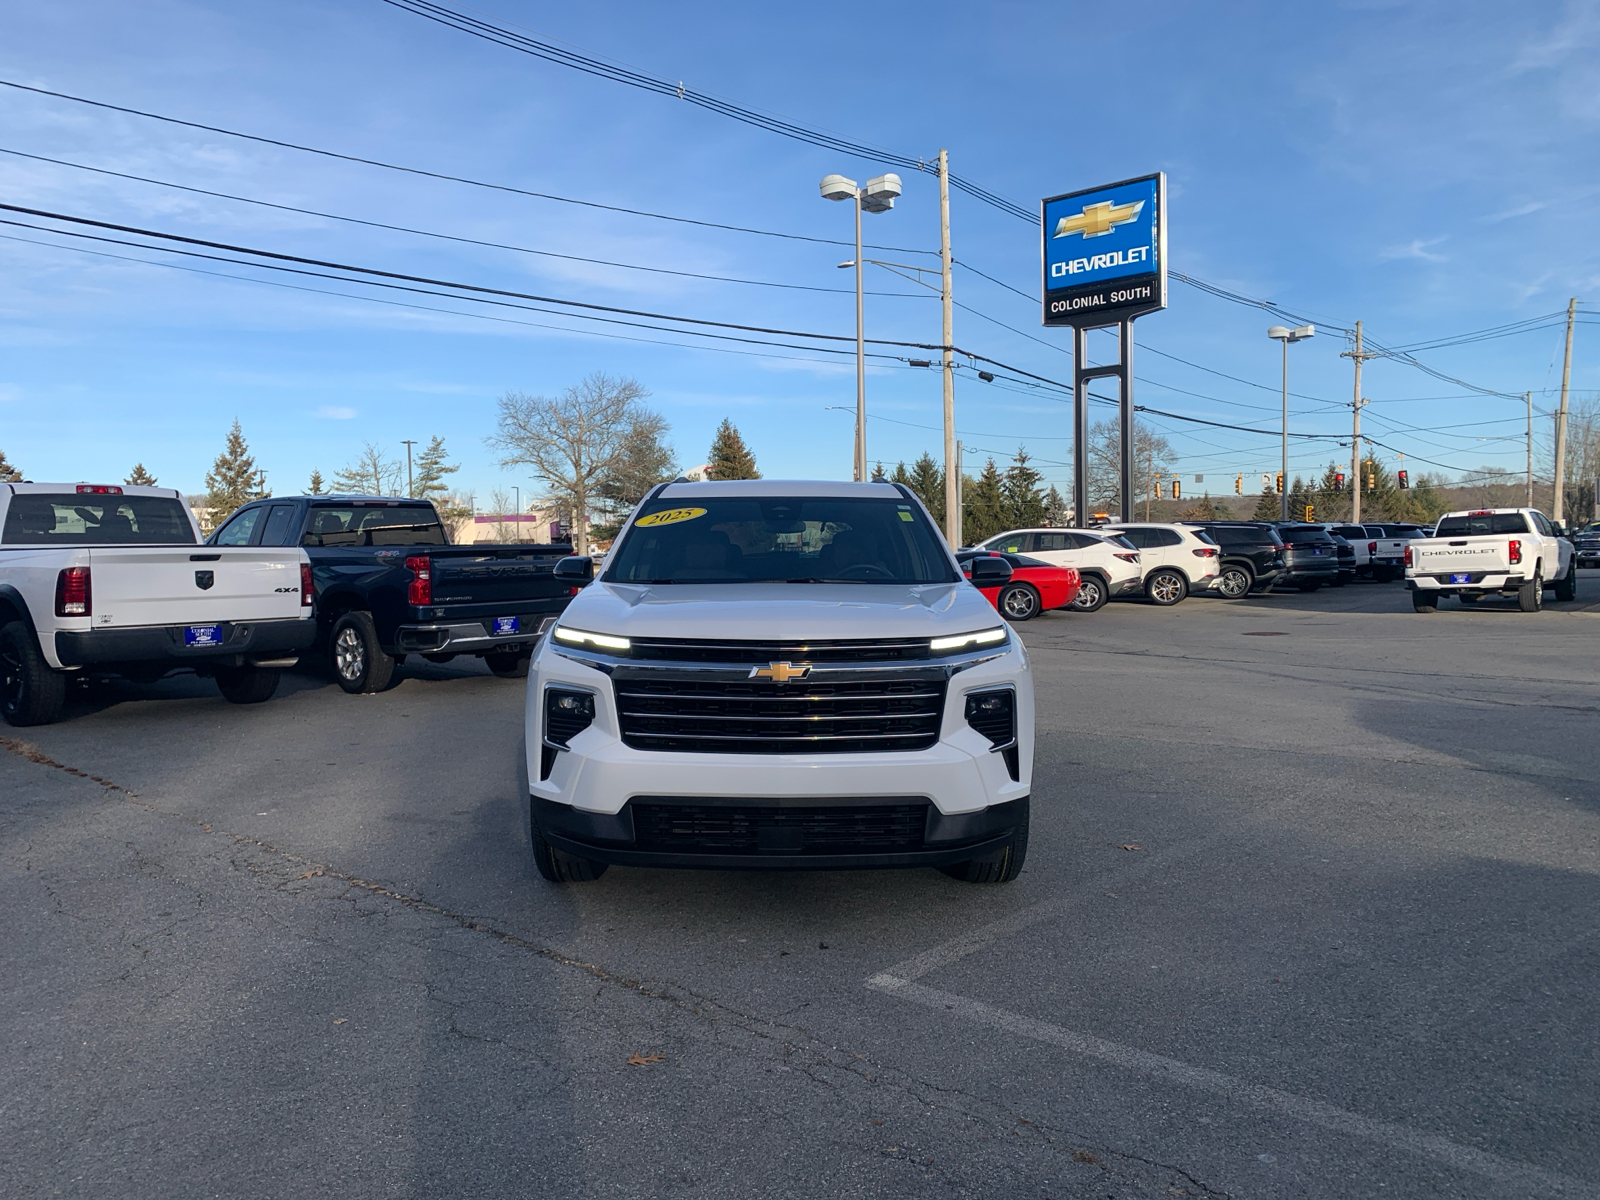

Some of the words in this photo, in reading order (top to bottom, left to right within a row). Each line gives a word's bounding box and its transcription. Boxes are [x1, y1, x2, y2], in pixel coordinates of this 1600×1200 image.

[1051, 246, 1150, 278] CHEVROLET
[1051, 294, 1107, 313] COLONIAL
[1110, 286, 1151, 302] SOUTH
[647, 508, 695, 525] 2025
[1422, 548, 1497, 556] CHEVROLET
[444, 565, 556, 579] CHEVROLE
